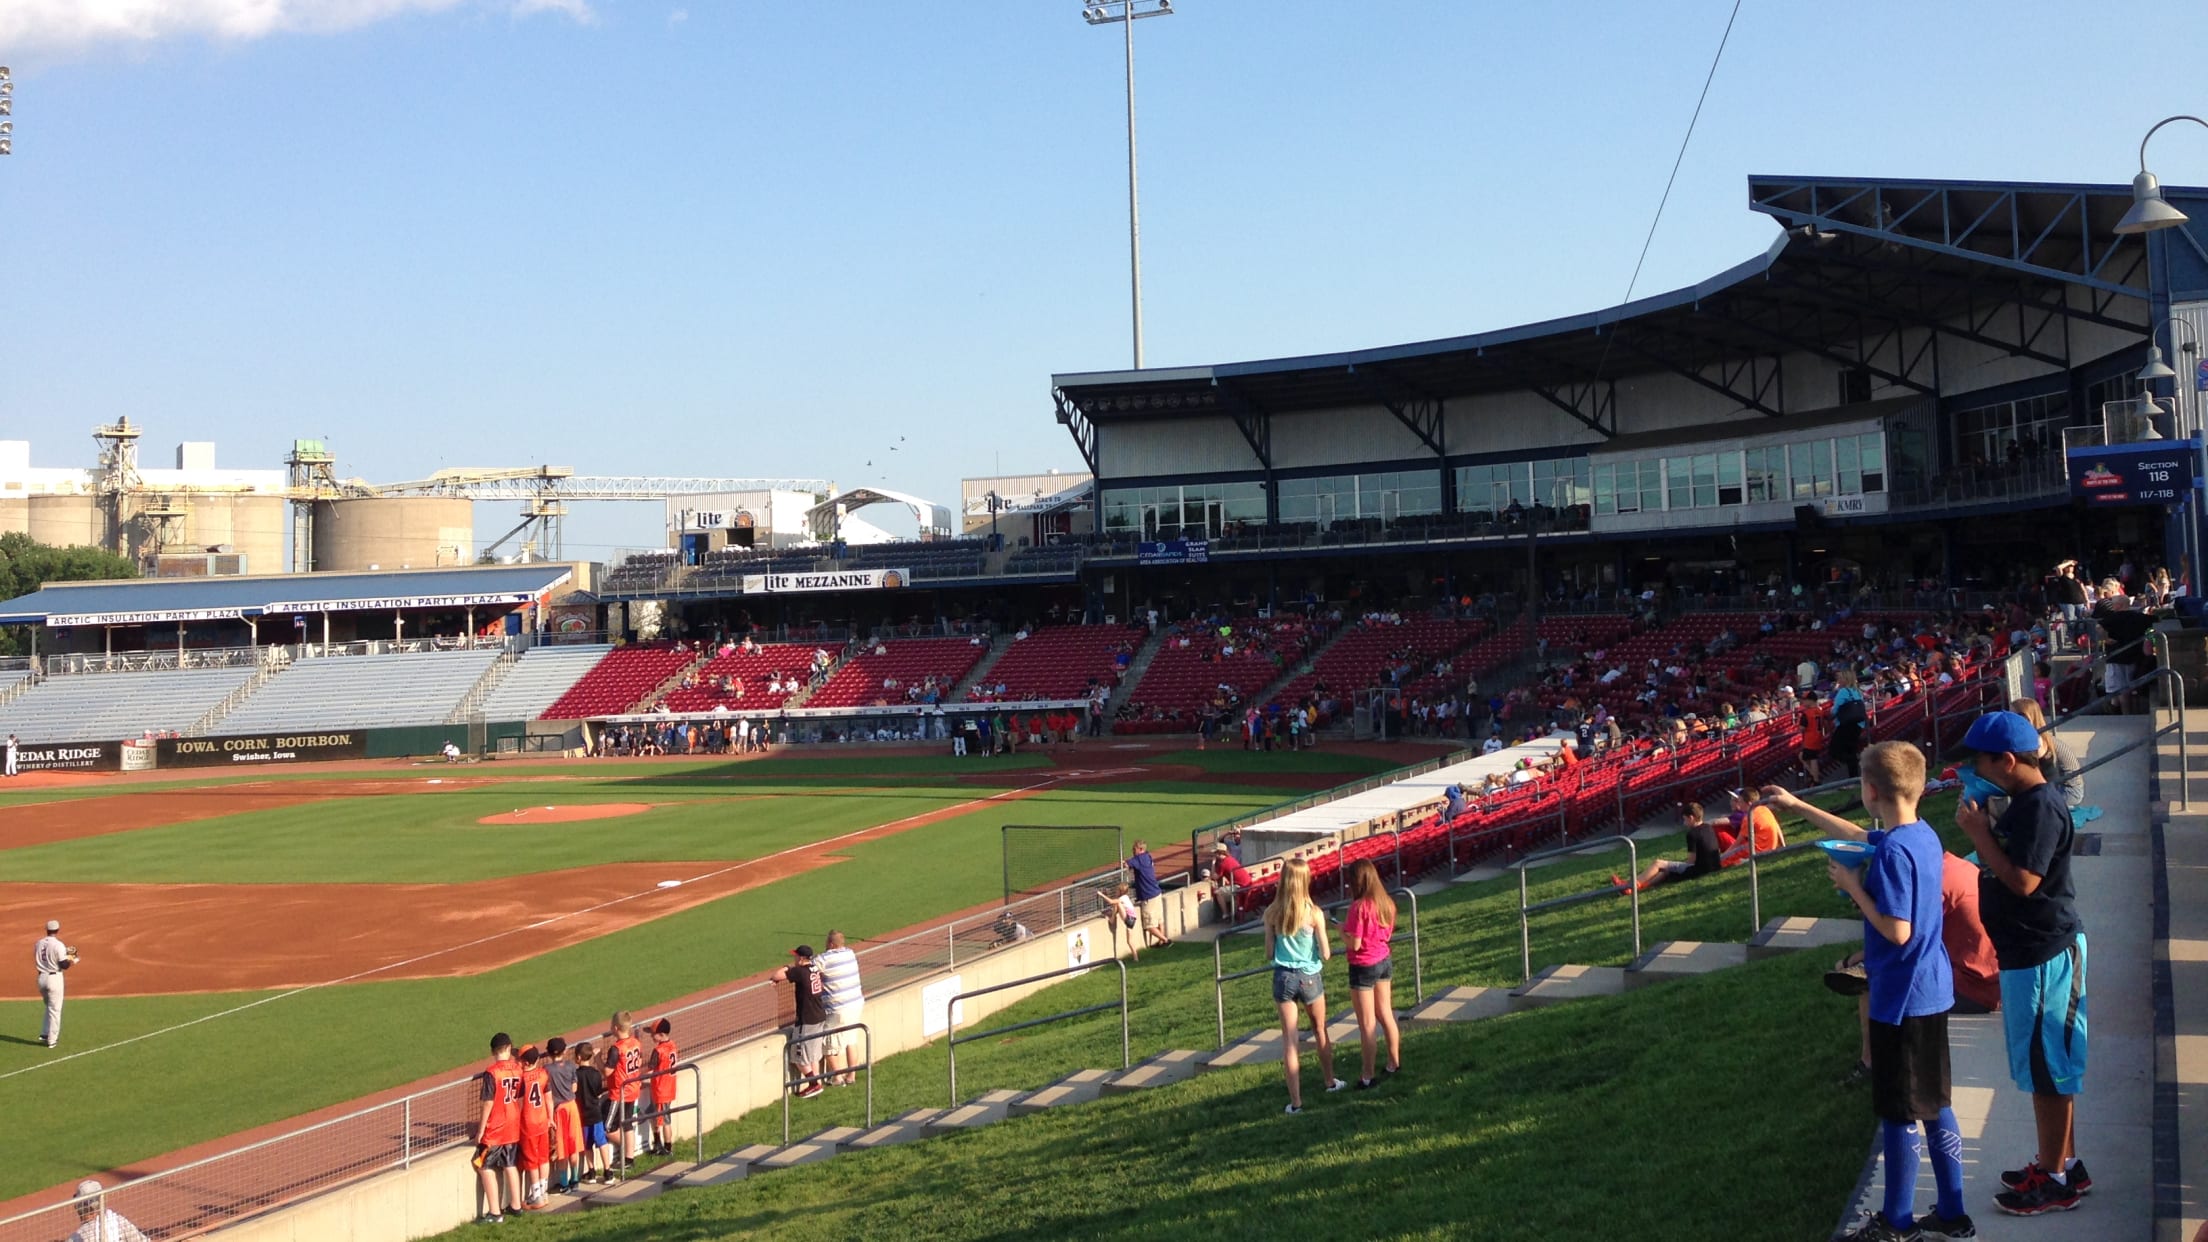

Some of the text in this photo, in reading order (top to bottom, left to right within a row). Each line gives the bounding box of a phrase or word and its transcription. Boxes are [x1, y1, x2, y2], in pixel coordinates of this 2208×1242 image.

[2137, 461, 2179, 470] SECTION
[2149, 471, 2169, 482] 118
[1837, 499, 1865, 511] KMRY
[696, 512, 722, 529] Lite
[764, 575, 789, 592] Lite
[795, 574, 872, 589] MEZZANINE
[282, 594, 502, 612] ARCTIC INSULATION PARTY PLAZA
[53, 609, 240, 625] ARCTIC INSULATION PARTY PLAZA
[176, 734, 352, 753] IOWA. CORN. BOURBON.
[14, 747, 102, 762] CEDAR RIDGE
[232, 751, 296, 761] Swisher, Iowa
[16, 762, 45, 770] WINERY
[52, 760, 94, 768] DISTILLERY
[626, 1047, 640, 1073] 22
[502, 1077, 520, 1104] 75
[528, 1081, 541, 1107] 4
